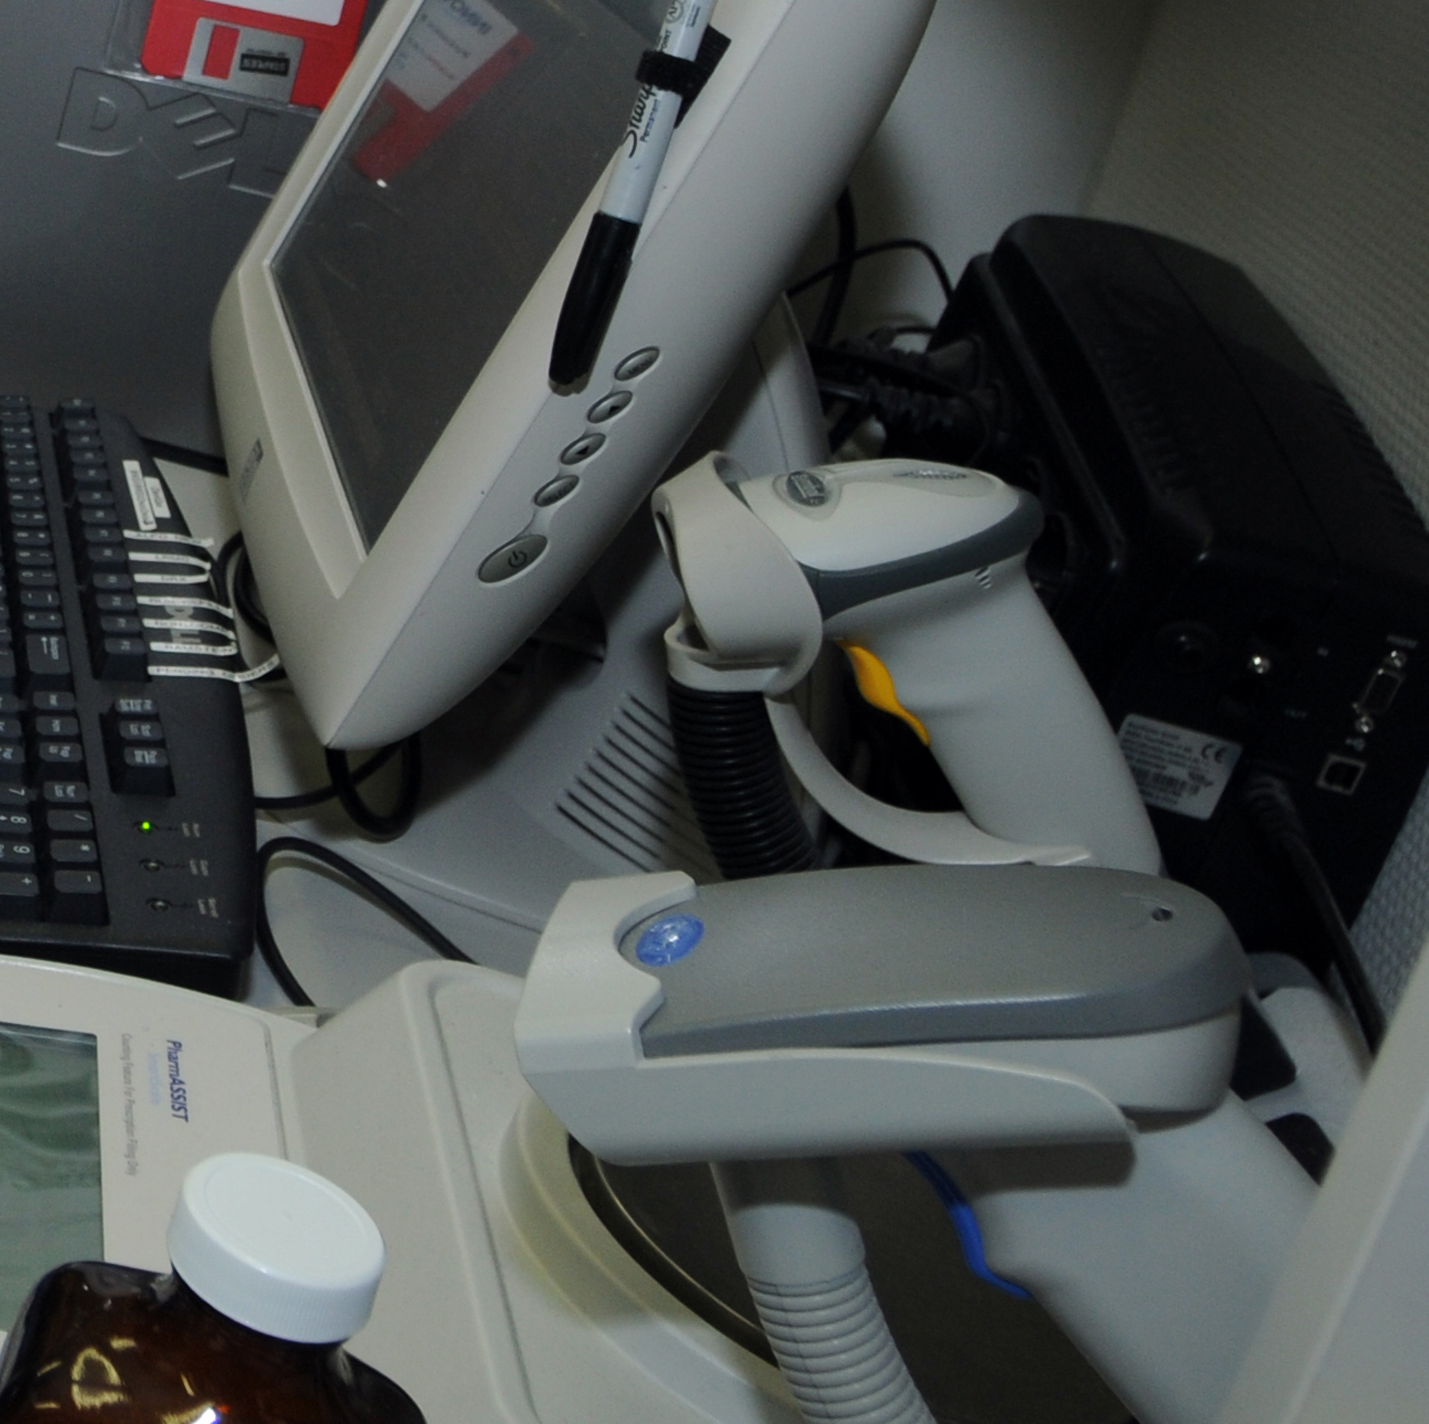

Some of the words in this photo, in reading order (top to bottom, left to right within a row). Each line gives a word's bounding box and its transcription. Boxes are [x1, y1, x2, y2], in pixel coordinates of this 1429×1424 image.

[7, 786, 25, 796] 7
[9, 815, 27, 823] 8
[12, 844, 31, 854] 9
[165, 1038, 189, 1123] PharmASSIST
